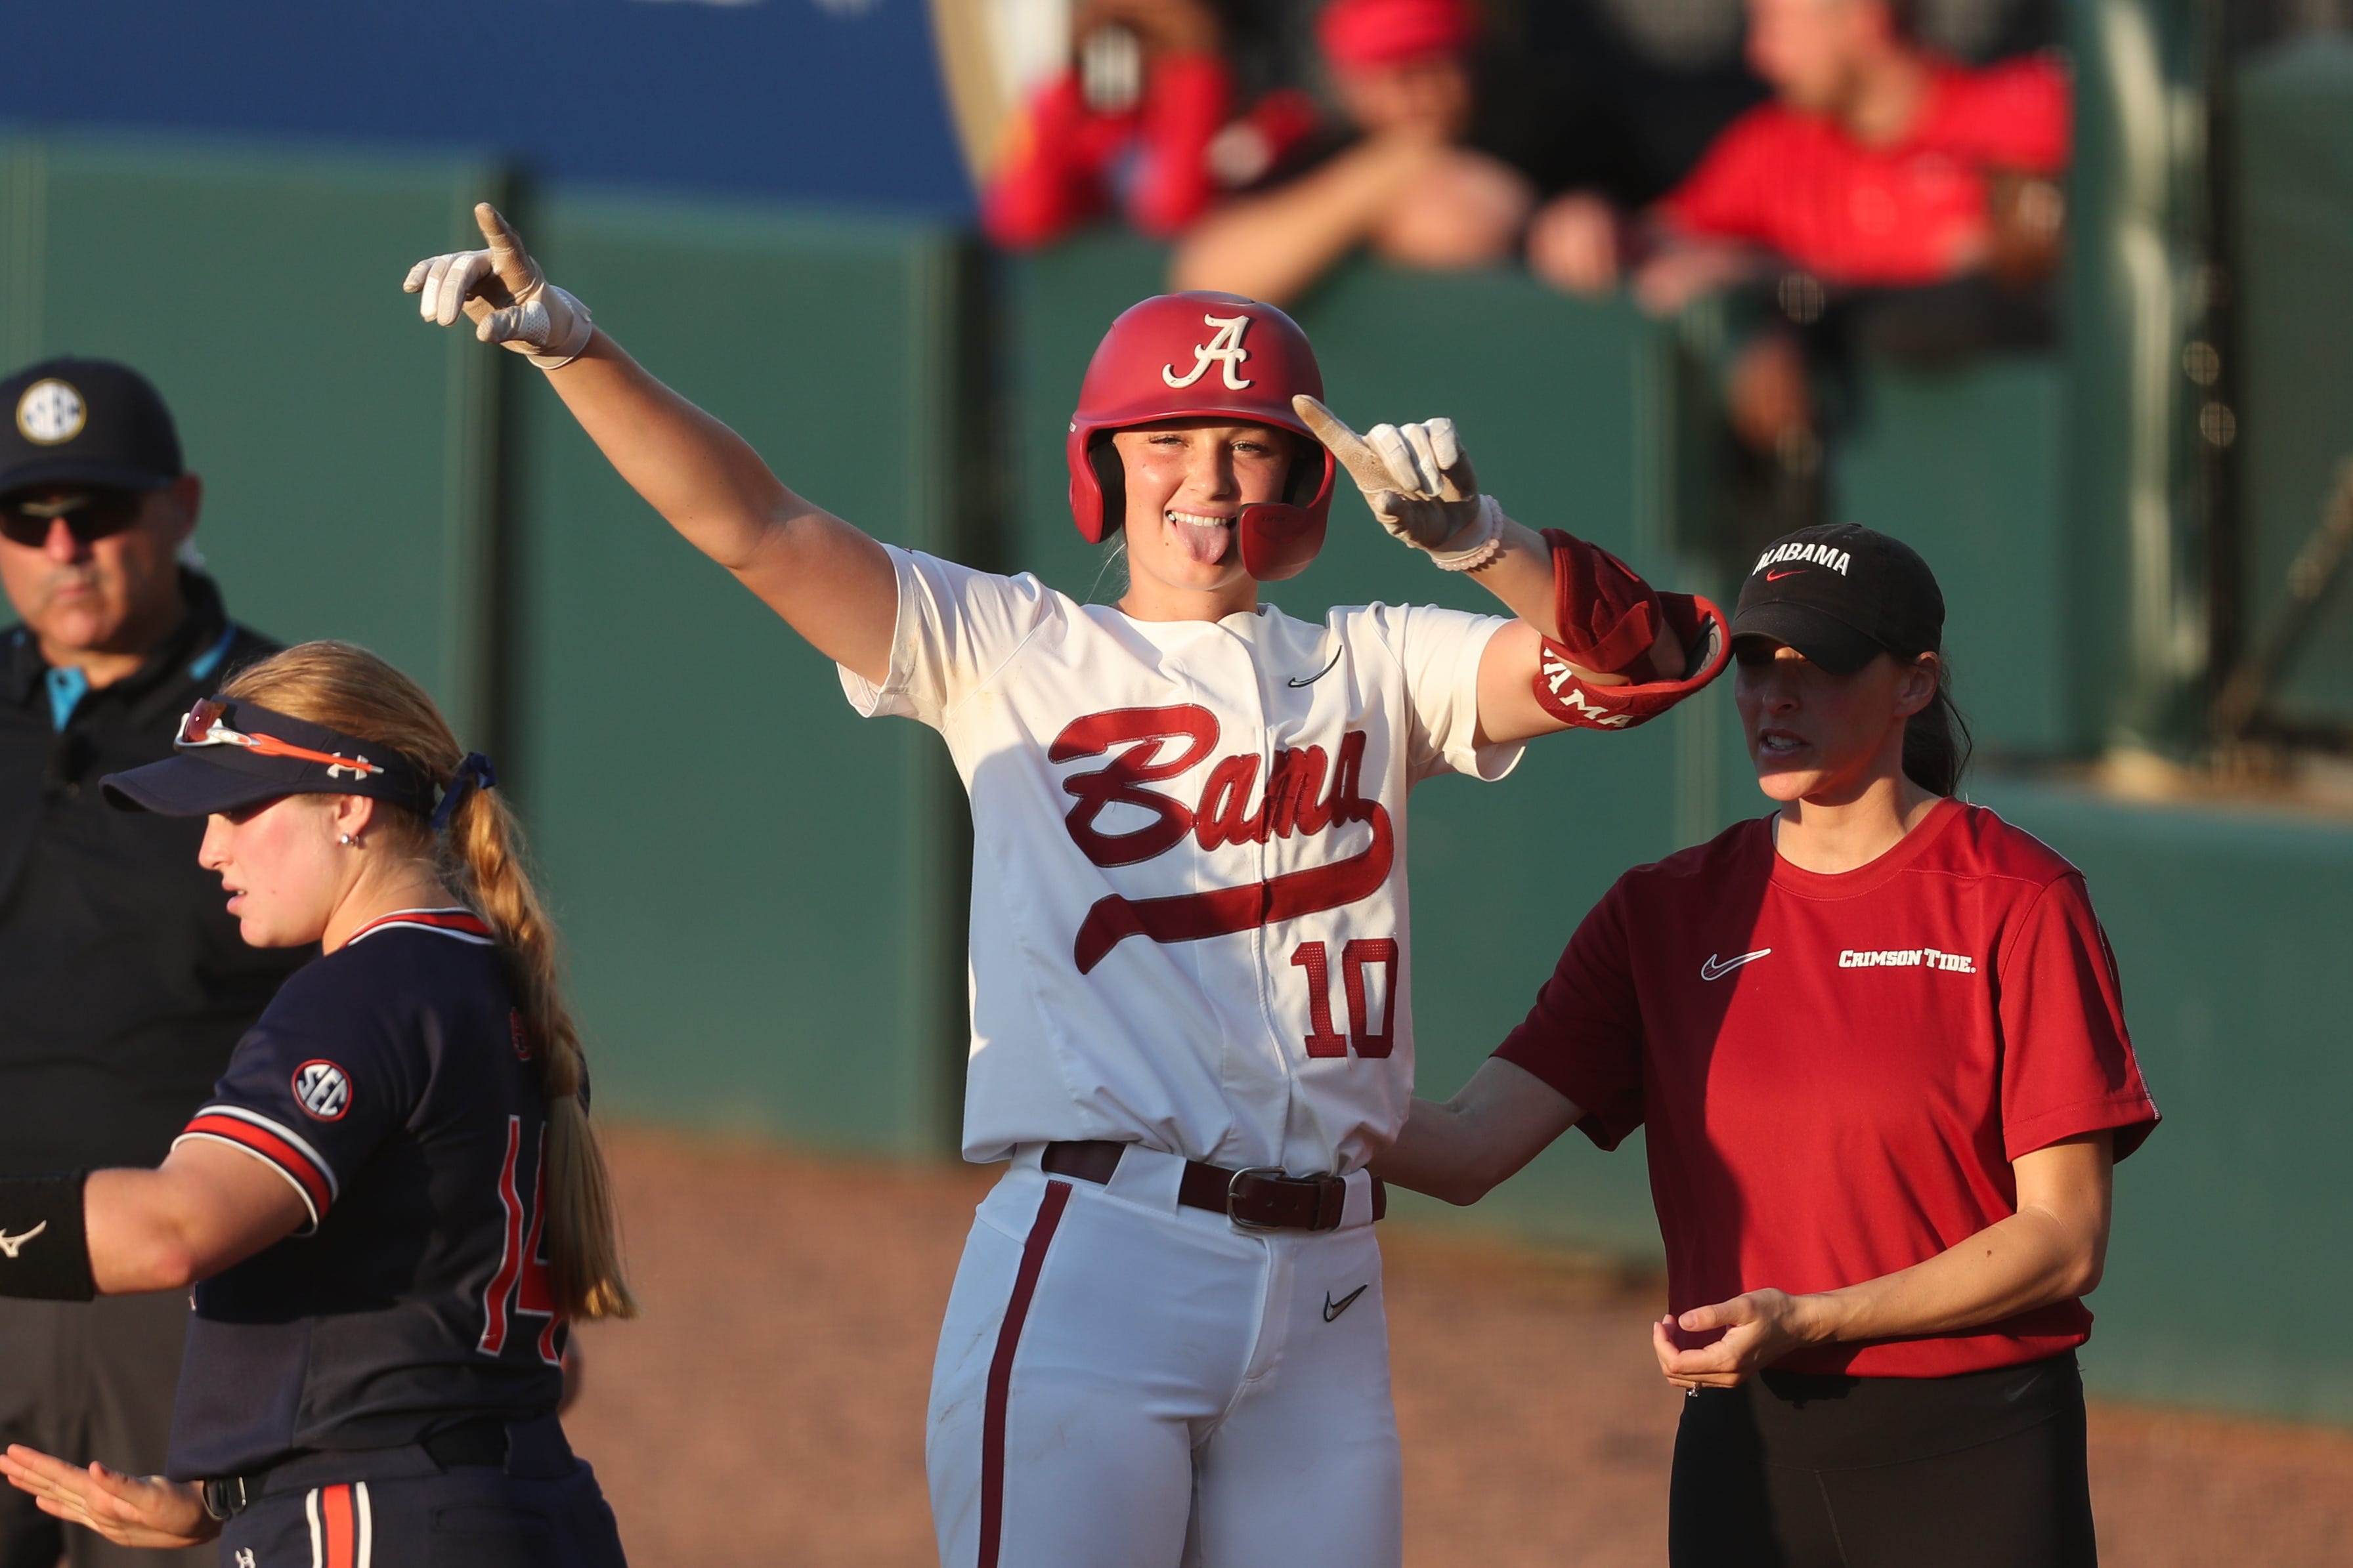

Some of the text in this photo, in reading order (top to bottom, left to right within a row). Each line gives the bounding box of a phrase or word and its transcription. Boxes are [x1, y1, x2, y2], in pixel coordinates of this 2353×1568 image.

[1161, 314, 1251, 391] A
[1752, 542, 1851, 577] ALABAMA
[1048, 702, 1394, 975] Bama
[1838, 949, 1923, 968] CRIMSON
[1291, 937, 1399, 1059] 10
[297, 1063, 348, 1116] SEC
